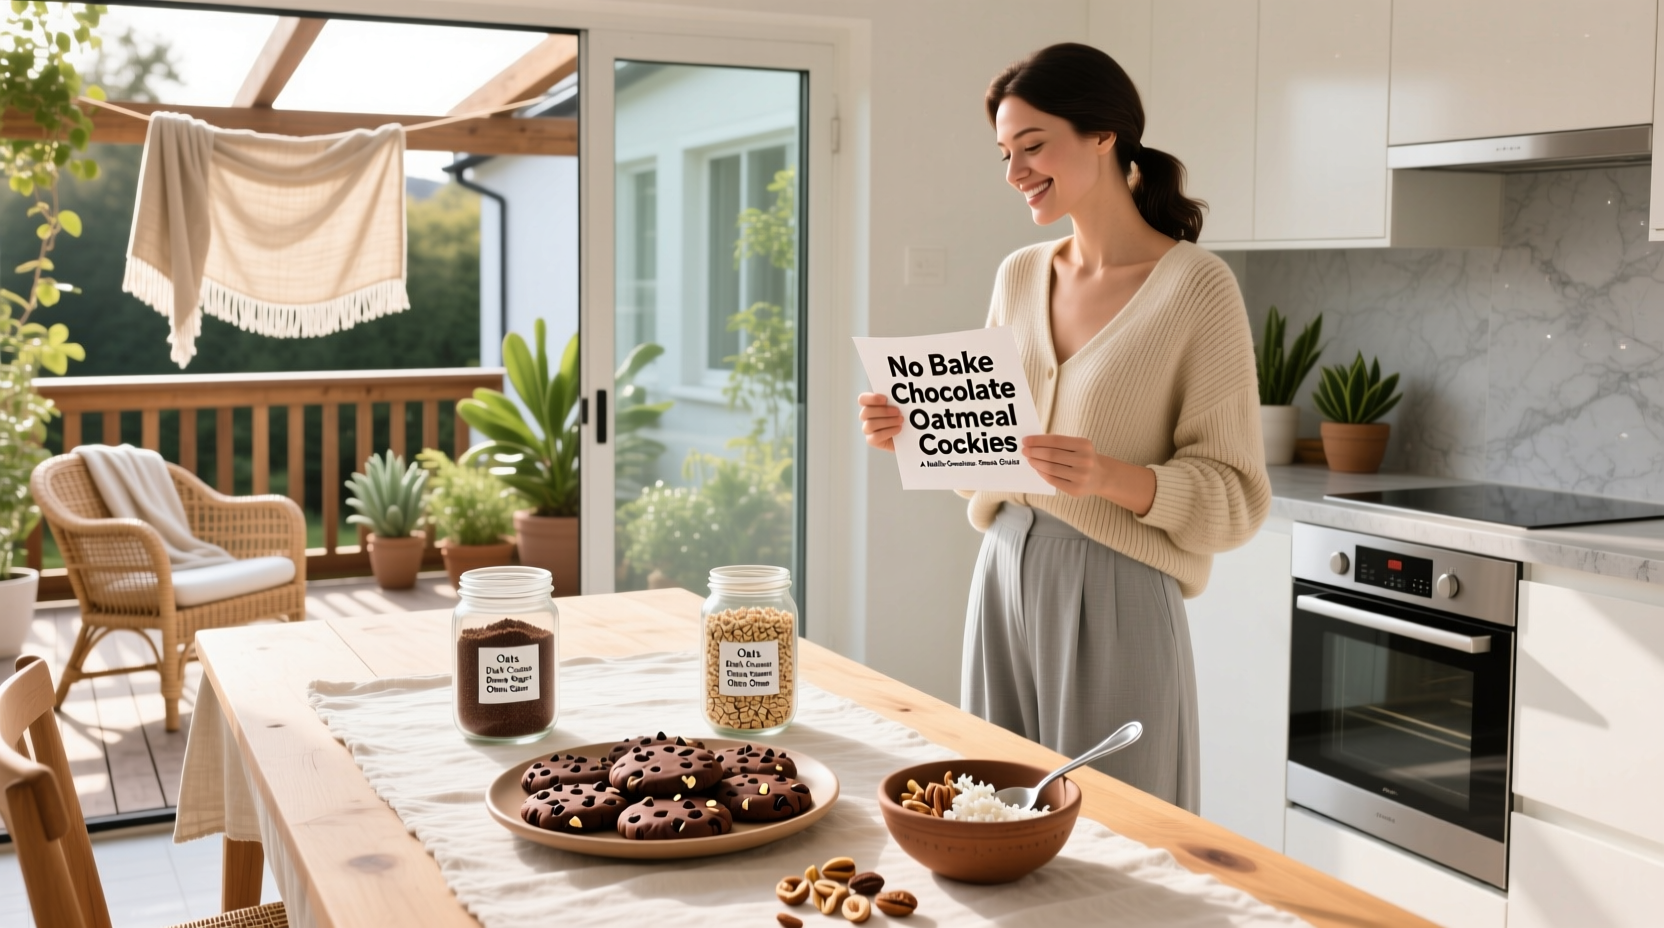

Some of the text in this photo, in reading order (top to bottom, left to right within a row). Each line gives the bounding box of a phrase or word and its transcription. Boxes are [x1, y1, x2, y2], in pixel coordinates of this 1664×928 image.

[887, 351, 994, 377] No Bake
[891, 378, 1016, 404] Chocolate
[909, 403, 1017, 430] Oatmeal
